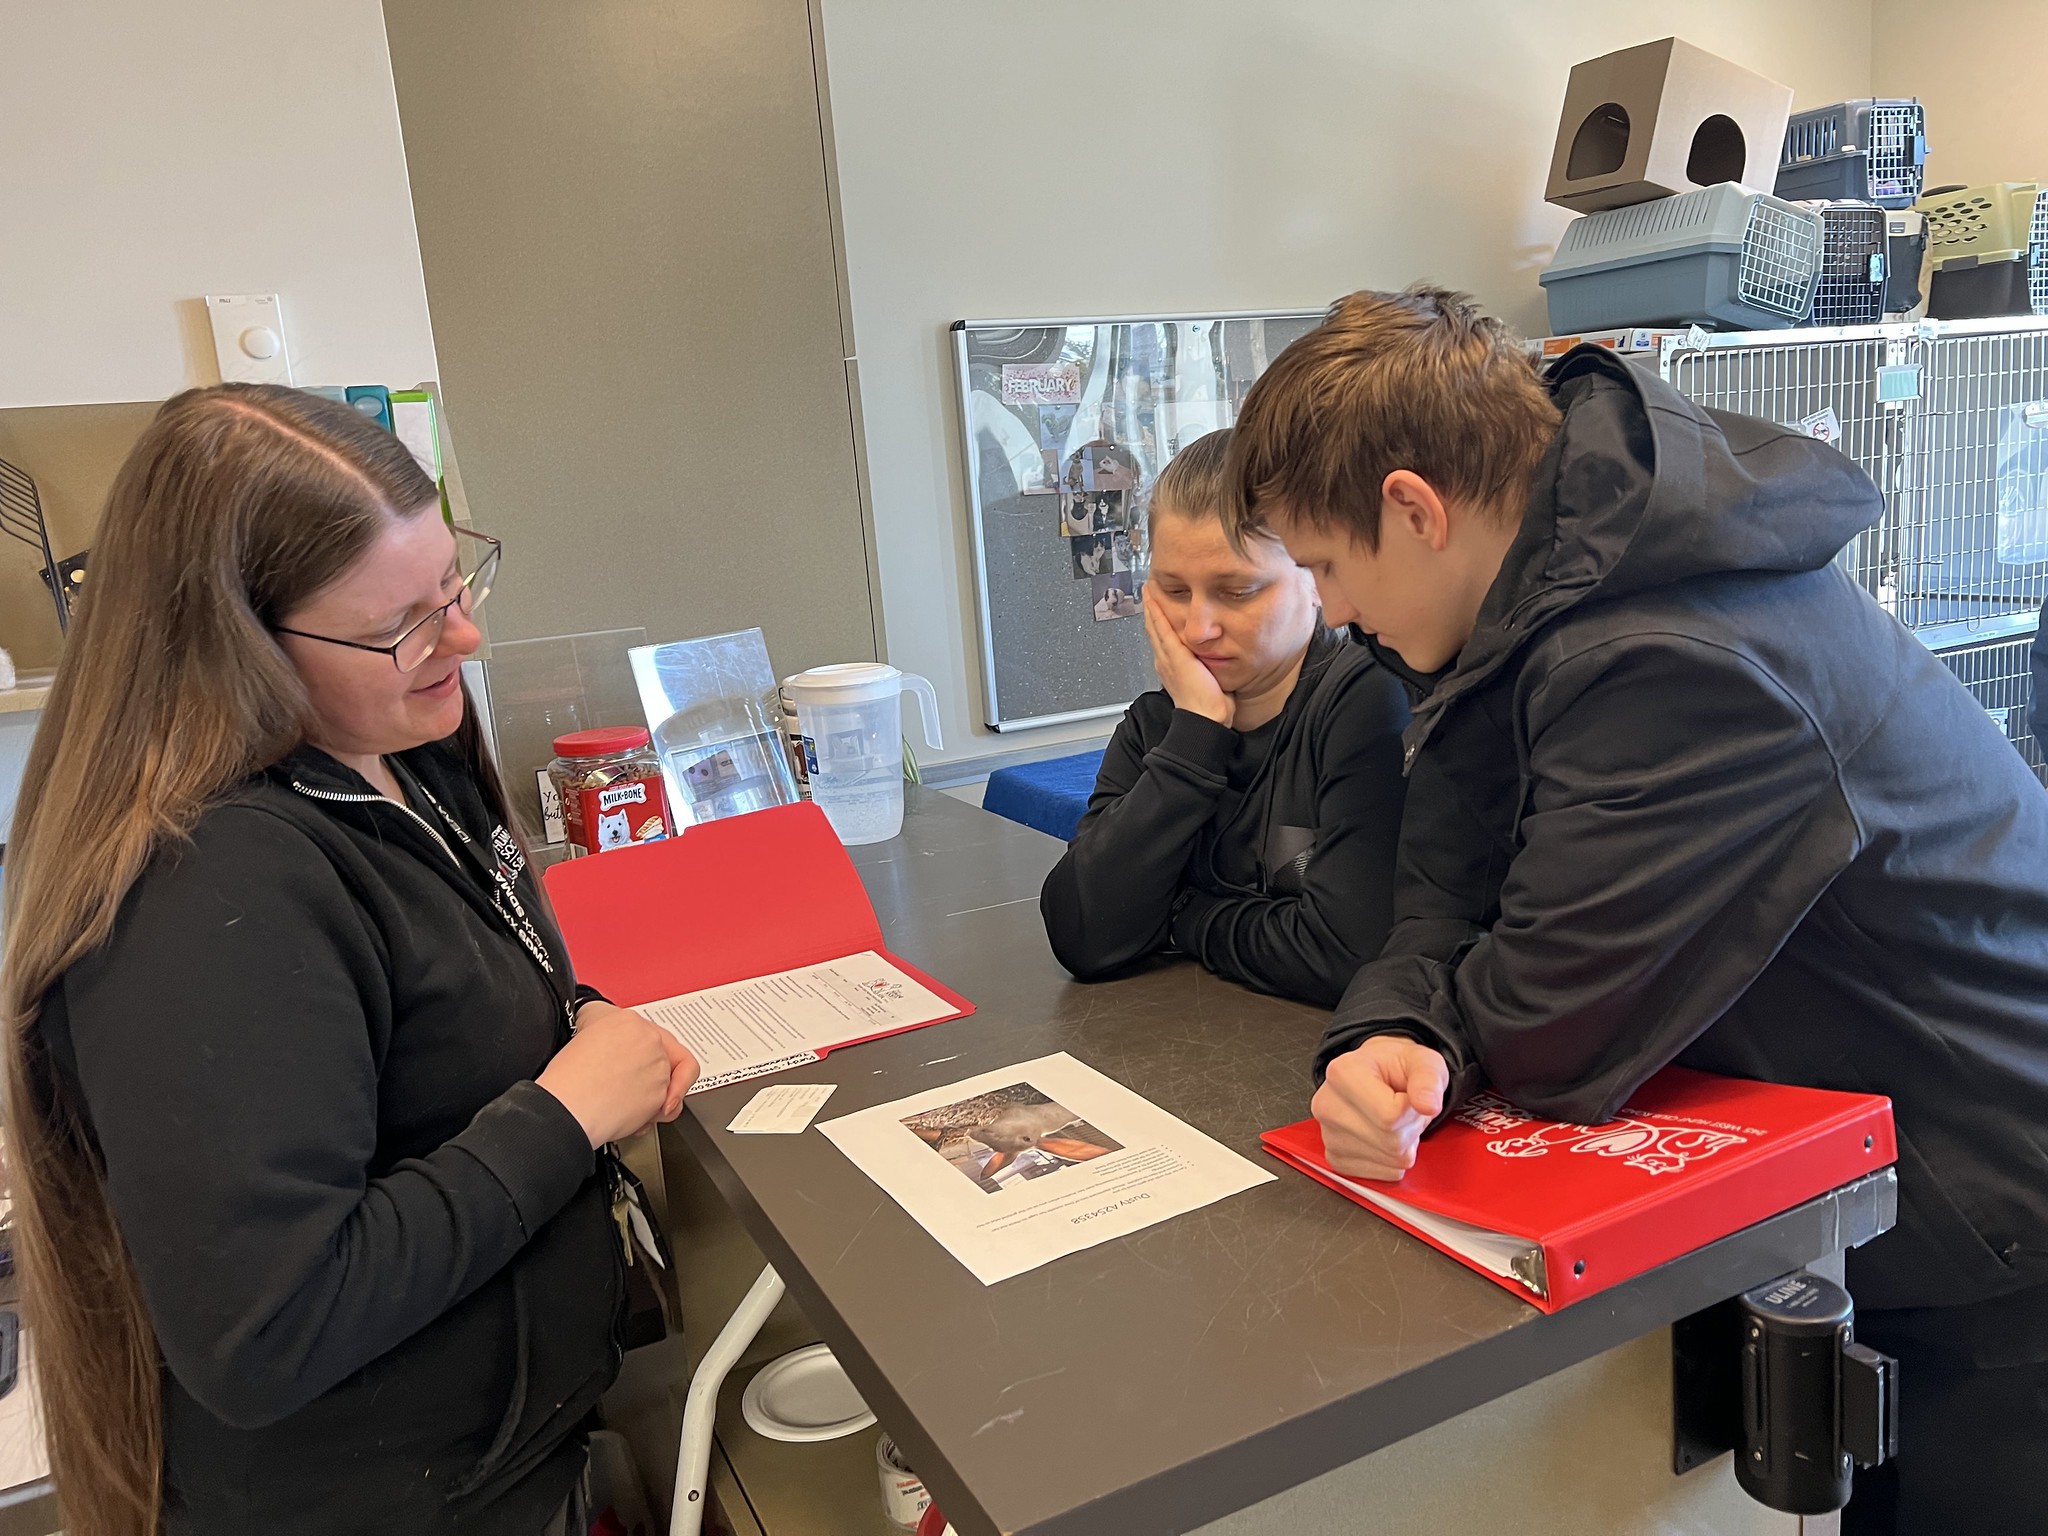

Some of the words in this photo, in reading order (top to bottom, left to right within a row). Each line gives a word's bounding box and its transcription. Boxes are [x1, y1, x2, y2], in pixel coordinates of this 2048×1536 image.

[1008, 377, 1073, 393] FEBRUARY
[1119, 1192, 1151, 1207] Dusty
[1070, 1203, 1118, 1225] A254358
[1764, 1280, 1807, 1305] ULINE
